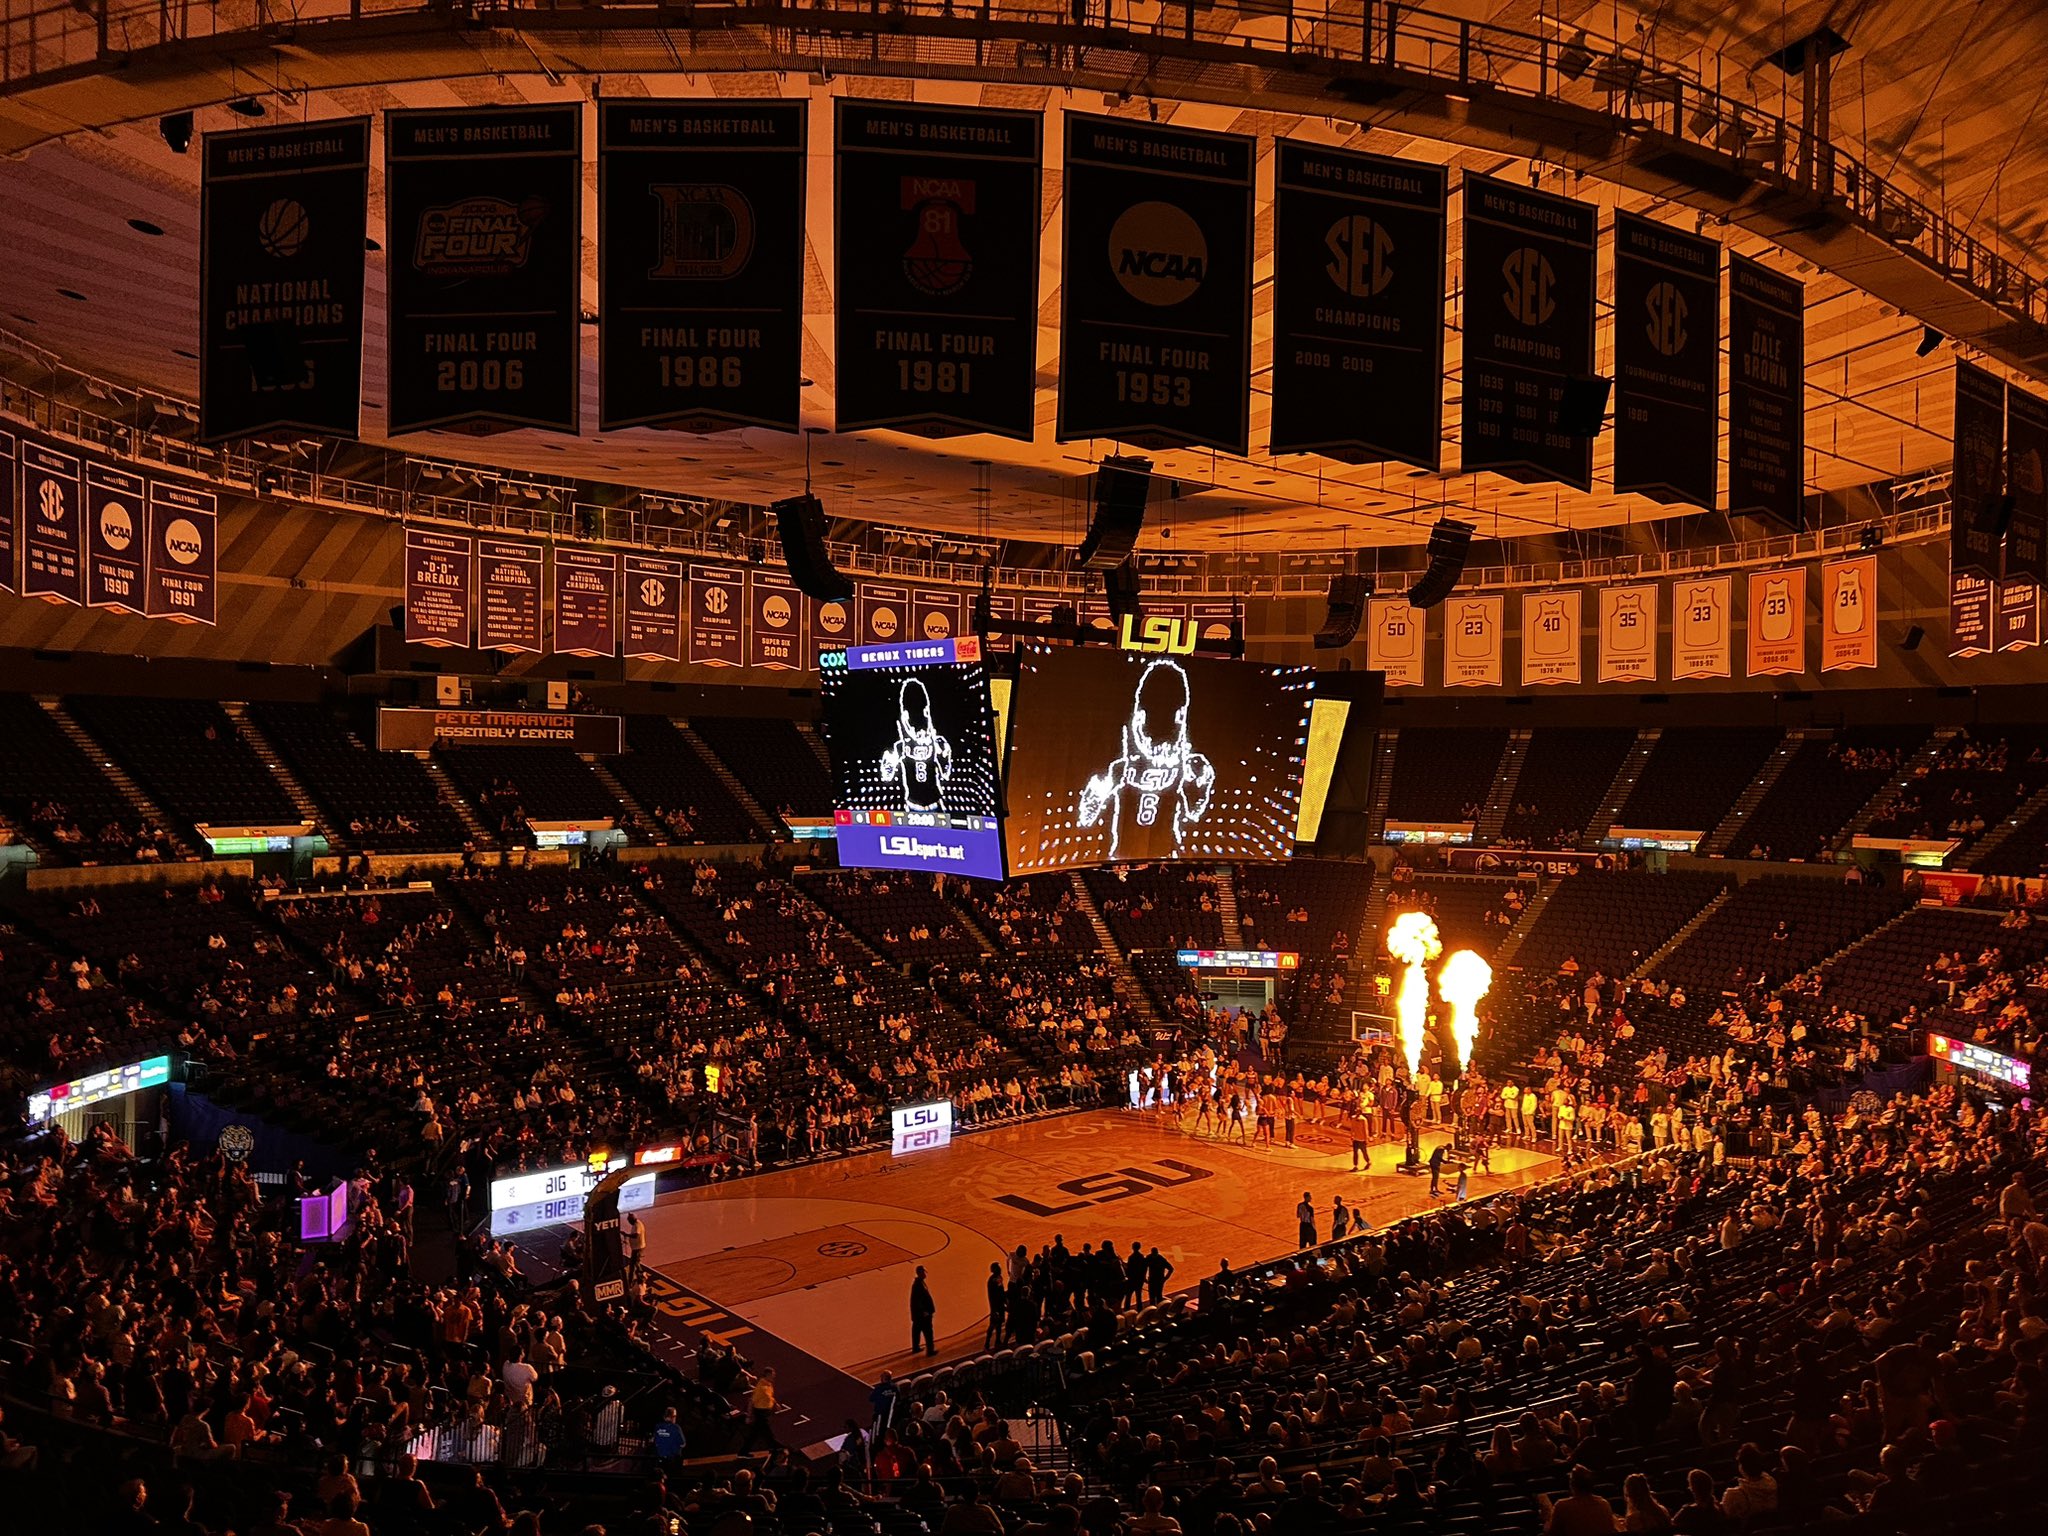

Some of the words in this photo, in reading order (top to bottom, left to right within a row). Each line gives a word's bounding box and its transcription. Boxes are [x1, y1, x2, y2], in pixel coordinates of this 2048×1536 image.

[414, 127, 458, 143] MEN'S
[464, 124, 552, 141] BASKETBALL
[630, 119, 677, 134] MEN'S
[683, 118, 776, 135] BASKETBALL
[866, 120, 913, 137] MEN'S
[918, 122, 1012, 144] BASKETBALL
[227, 147, 265, 163] MEN'S
[268, 139, 344, 160] BASKETBALL
[1094, 135, 1138, 154] MEN'S
[1143, 143, 1228, 167] BASKETBALL
[1303, 161, 1343, 180] MEN'S
[1346, 167, 1423, 195] BASKETBALL
[913, 179, 960, 197] NCAA
[1484, 193, 1516, 214] MEN'S
[448, 217, 518, 234] FINAL
[924, 209, 952, 234] 81
[423, 233, 516, 257] FOUR
[1324, 213, 1396, 298] SEC
[1119, 248, 1203, 283] NCAA
[235, 278, 332, 305] NATIONAL
[1501, 247, 1557, 327] SEC
[1315, 307, 1401, 332] CHAMPIONS
[1645, 280, 1689, 357] SEC
[424, 331, 481, 353] FINAL
[487, 330, 537, 353] FOUR
[641, 328, 698, 348] FINAL
[707, 328, 761, 348] FOUR
[875, 330, 933, 353] FINAL
[941, 333, 995, 356] FOUR
[1494, 333, 1561, 360] CHAMPIONS
[1752, 331, 1782, 362] DALE
[1099, 342, 1153, 366] FINAL
[1160, 347, 1210, 372] FOUR
[1295, 351, 1331, 369] 2009
[1342, 356, 1374, 374] 2019
[437, 359, 525, 391] 2006
[658, 355, 743, 388] 1986
[898, 359, 971, 394] 1981
[1744, 353, 1788, 389] BROWN
[1115, 371, 1192, 408] 1953
[38, 479, 65, 522] SEC
[104, 523, 132, 540] NCAA
[169, 539, 201, 554] NCAA
[99, 563, 116, 578] FINAL
[117, 568, 135, 581] FOUR
[417, 571, 459, 586] BREAUX
[490, 574, 531, 584] CHAMPIONS
[495, 567, 527, 577] NATIONAL
[570, 575, 601, 584] NATIONAL
[104, 577, 129, 596] 1990
[161, 577, 182, 591] FINAL
[184, 580, 204, 592] FOUR
[566, 581, 605, 591] CHAMPIONS
[640, 578, 665, 606] SEC
[169, 591, 195, 607] 1991
[705, 587, 728, 614] SEC
[1768, 599, 1785, 616] 33
[1840, 589, 1857, 607] 34
[766, 610, 790, 620] NCAA
[823, 616, 845, 625] NCAA
[1619, 612, 1637, 627] 35
[1693, 606, 1711, 622] 33
[2009, 614, 2027, 631] 1977
[874, 621, 897, 630] NCAA
[927, 625, 949, 634] NCAA
[1119, 613, 1199, 655] LSU
[1388, 623, 1405, 636] 50
[1465, 622, 1483, 635] 23
[1543, 617, 1560, 632] 40
[762, 637, 780, 645] SUPER
[781, 639, 791, 647] SIX
[764, 646, 788, 657] 2008
[820, 652, 847, 668] COX
[434, 712, 482, 726] PETE
[486, 714, 575, 728] MARAVICH
[434, 727, 517, 739] ASSEMBLY
[519, 728, 575, 740] CENTER
[1137, 793, 1160, 826] 6
[880, 836, 965, 860] LSUsports.net
[1377, 984, 1390, 995] 30
[705, 1077, 718, 1093] 30
[904, 1109, 938, 1128] LSU
[1044, 1120, 1127, 1140] COX
[545, 1175, 566, 1194] BIG
[992, 1159, 1215, 1217] LSU
[594, 1218, 619, 1231] YETI
[597, 1282, 622, 1298] MMR
